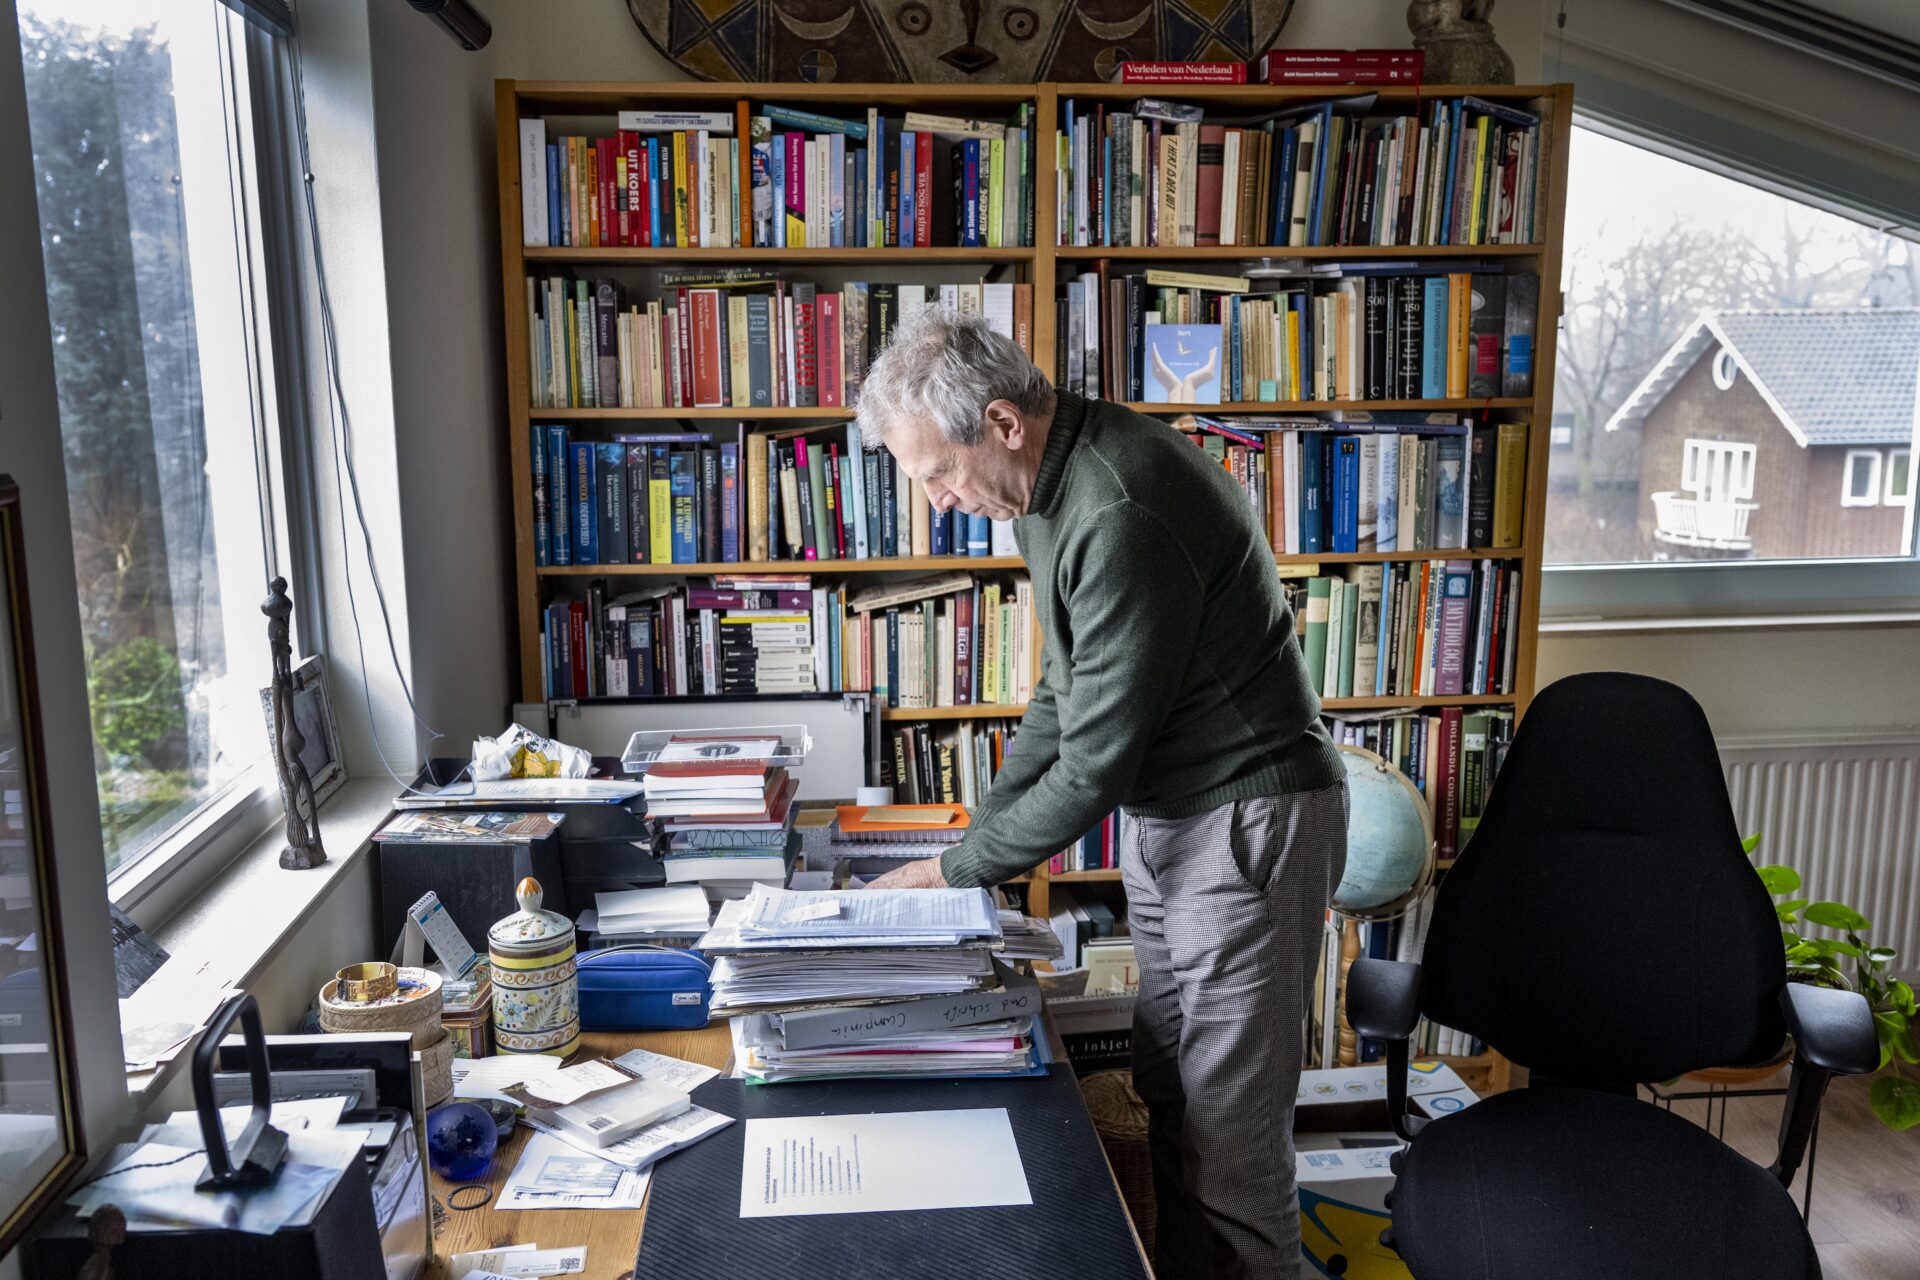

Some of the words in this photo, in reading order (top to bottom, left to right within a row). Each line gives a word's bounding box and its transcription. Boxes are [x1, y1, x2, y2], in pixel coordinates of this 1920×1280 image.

[1127, 64, 1167, 73] Verleden
[1186, 65, 1232, 73] Nederland
[628, 150, 637, 169] UIT
[1167, 144, 1177, 169] HERT
[774, 158, 782, 186] VENTOUX
[1166, 178, 1176, 193] DER
[629, 173, 639, 211] KOERS
[1165, 196, 1175, 211] UUT
[918, 217, 927, 242] PARIJS
[1367, 296, 1385, 306] 500
[1404, 304, 1420, 312] 150
[1433, 300, 1441, 349] EEUWIGHEID
[795, 304, 815, 386] REVOLUSI
[578, 448, 587, 473] GRAHAM
[579, 474, 588, 500] HANCOCK
[580, 502, 589, 546] ONDERWERELD
[957, 627, 968, 660] BELGIË
[1431, 631, 1440, 668] GETOUWEN
[1441, 608, 1464, 674] MYTHOLOGIE
[1410, 724, 1418, 765] Deutschland
[1448, 720, 1458, 774] HOLLANDIA
[942, 767, 952, 791] You
[1446, 776, 1455, 829] COMITATUS
